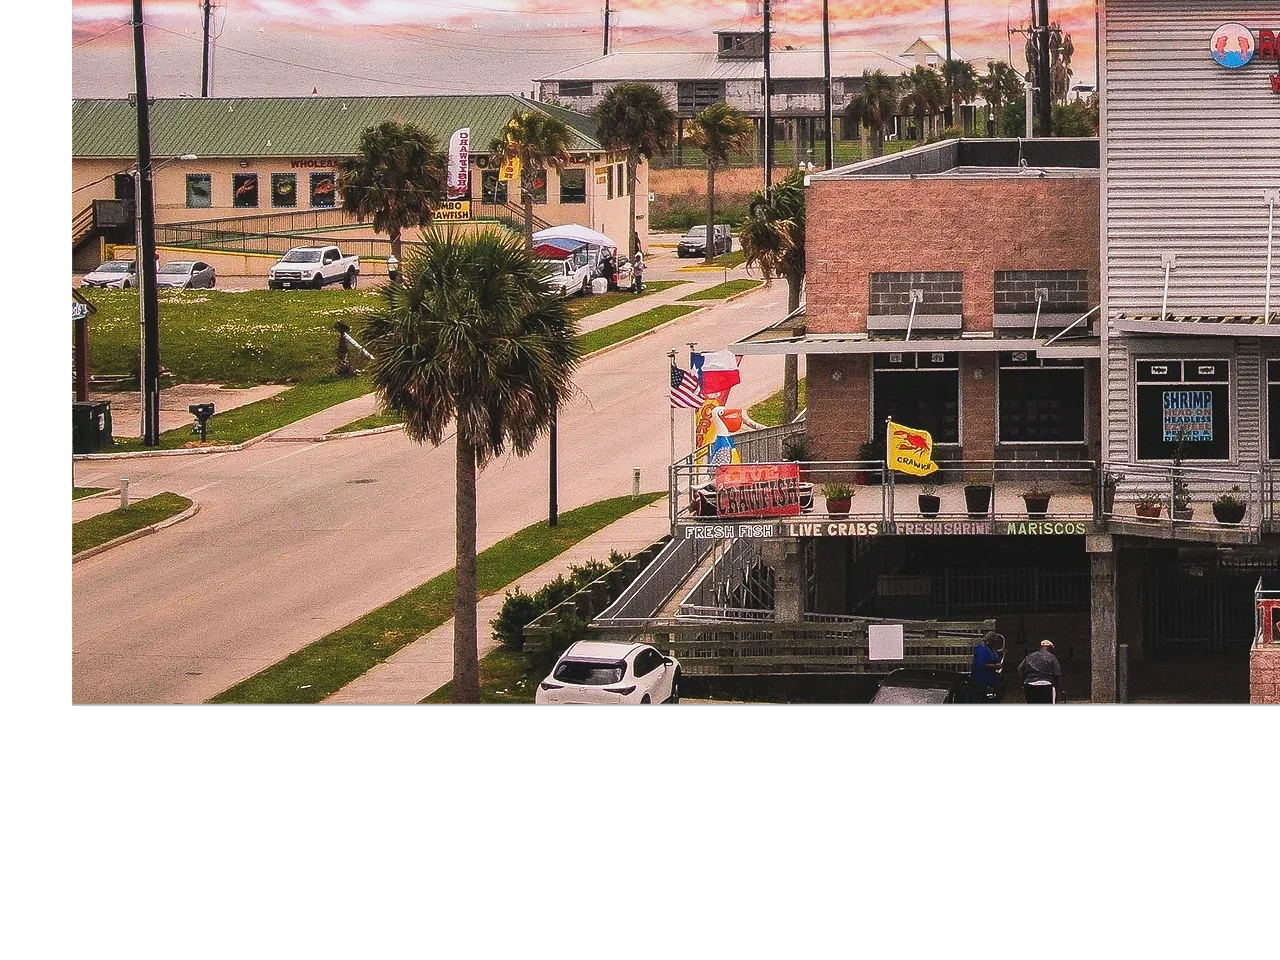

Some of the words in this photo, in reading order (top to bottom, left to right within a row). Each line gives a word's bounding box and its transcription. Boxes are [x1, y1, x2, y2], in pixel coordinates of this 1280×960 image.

[1164, 392, 1212, 409] SHRIMP
[1164, 416, 1212, 424] HEADLESS
[717, 478, 798, 515] CRAWFISH
[685, 525, 735, 539] FRESH
[789, 523, 822, 537] LIVE
[827, 523, 879, 536] CRABS
[896, 523, 943, 536] FRESH
